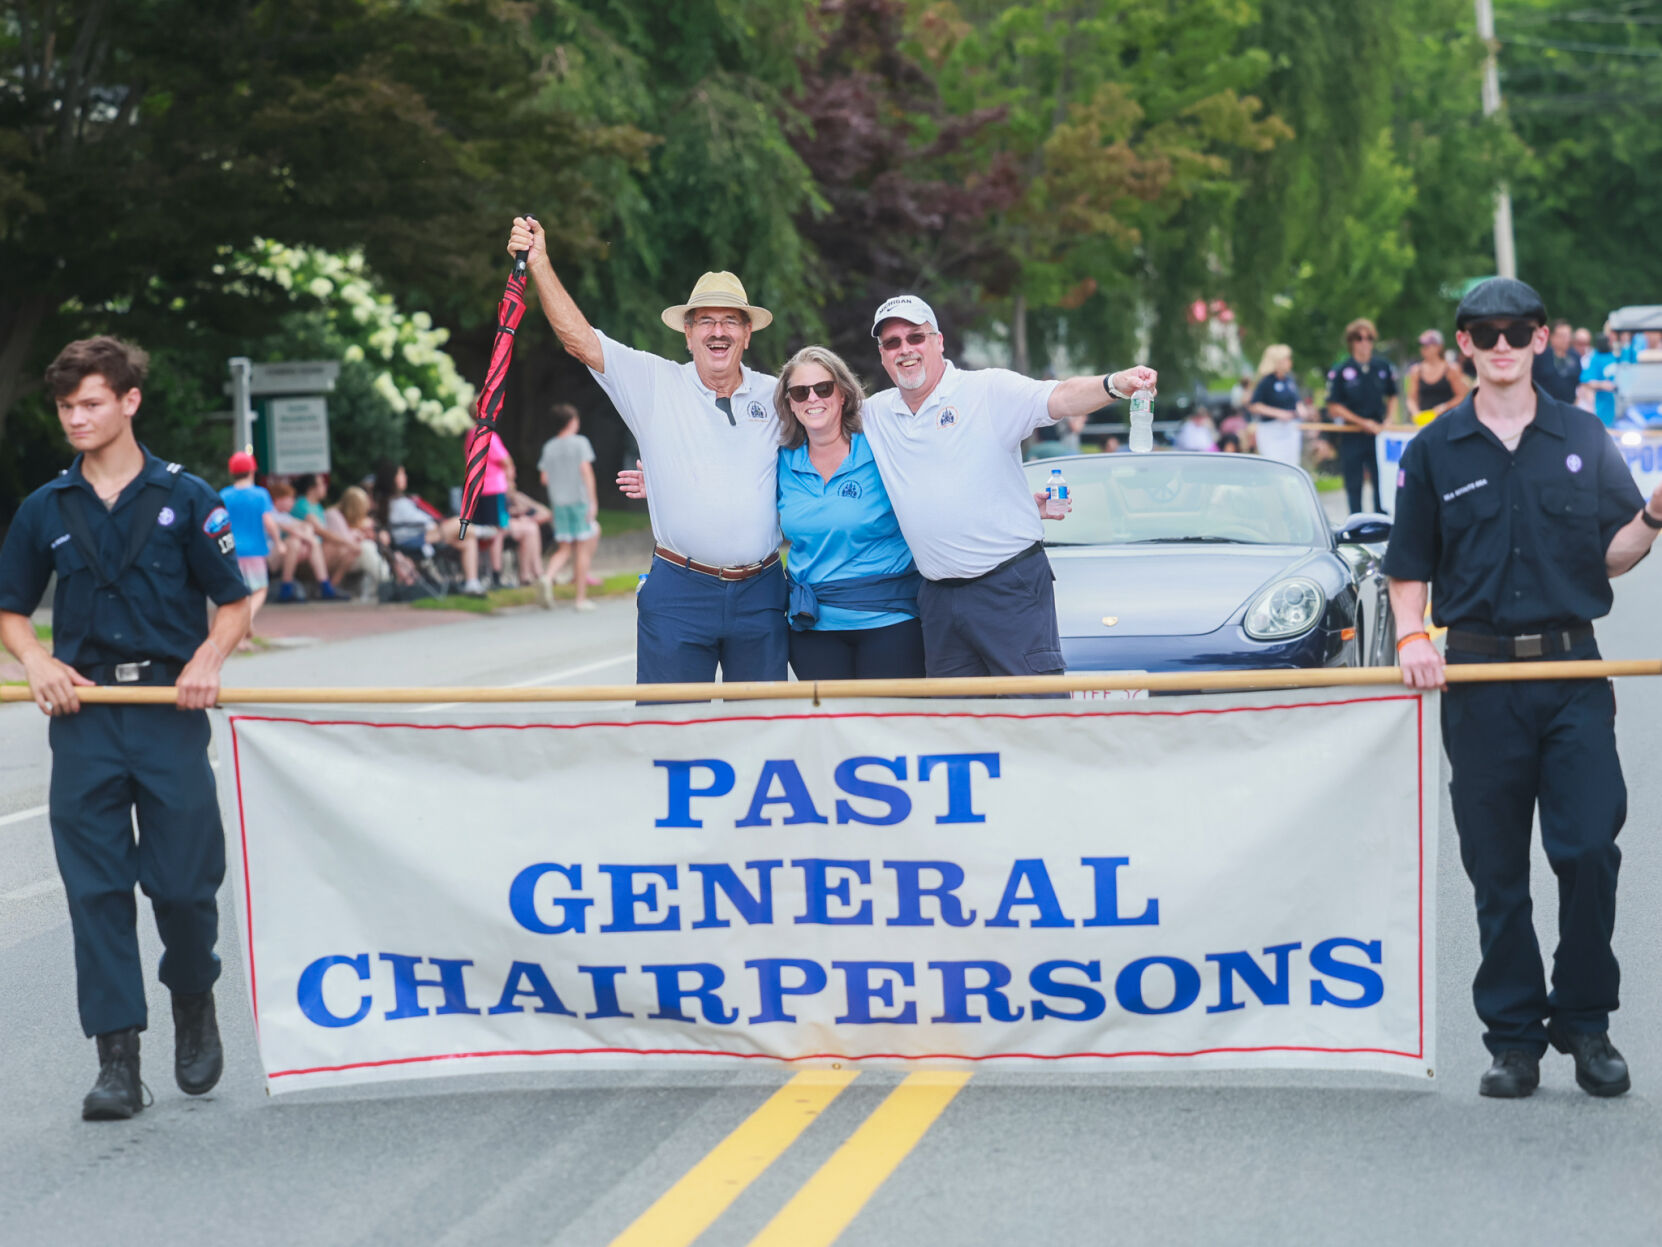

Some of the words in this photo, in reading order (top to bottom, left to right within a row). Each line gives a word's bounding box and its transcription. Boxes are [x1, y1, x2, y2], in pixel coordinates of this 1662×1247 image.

[879, 298, 912, 315] MICHIGAN
[653, 751, 1001, 830] PAST
[508, 855, 1160, 936] GENERAL
[296, 936, 1385, 1029] CHAIRPERSONS
